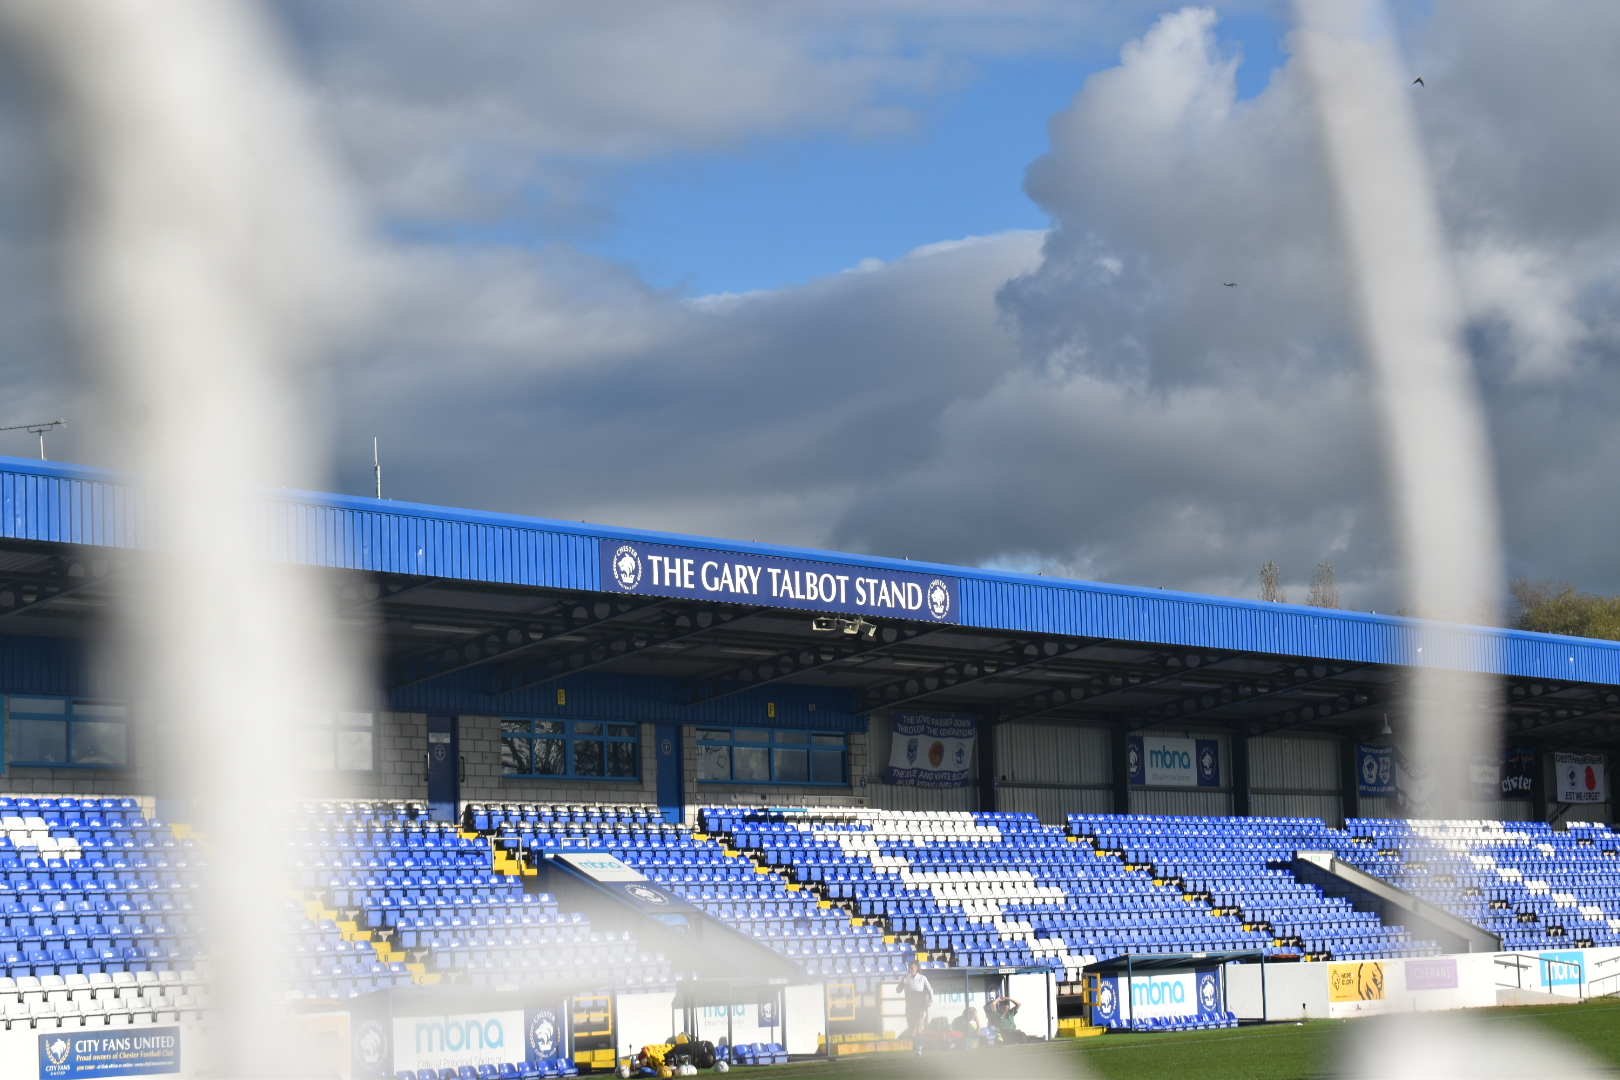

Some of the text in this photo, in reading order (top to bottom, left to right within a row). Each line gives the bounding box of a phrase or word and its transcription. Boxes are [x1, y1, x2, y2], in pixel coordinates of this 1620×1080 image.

[617, 545, 637, 558] CHESTER
[648, 554, 923, 611] THE GARY TALBOT STAND
[769, 704, 773, 715] F
[903, 714, 971, 727] THE LOVE PASSED DOWN
[897, 723, 976, 737] THROUGH THE GENERATIONS
[1150, 745, 1190, 769] mbna
[892, 769, 905, 778] THE
[918, 771, 934, 780] AND
[1501, 774, 1532, 792] chster
[1575, 792, 1582, 800] WE
[1414, 966, 1451, 980] CURRANS
[1132, 975, 1184, 1006] mbna
[533, 1011, 556, 1023] CHESTER
[358, 1019, 383, 1033] CHESTER
[317, 1030, 339, 1040] HOPE
[416, 1015, 504, 1053] mbna
[75, 1036, 174, 1053] CITY FANS UNITED
[317, 1040, 343, 1049] GLORY
[76, 1053, 92, 1061] Proud
[113, 1051, 118, 1060] of
[119, 1050, 139, 1059] Chester
[140, 1050, 162, 1058] Football
[162, 1049, 174, 1057] Club
[418, 1058, 441, 1070] Official
